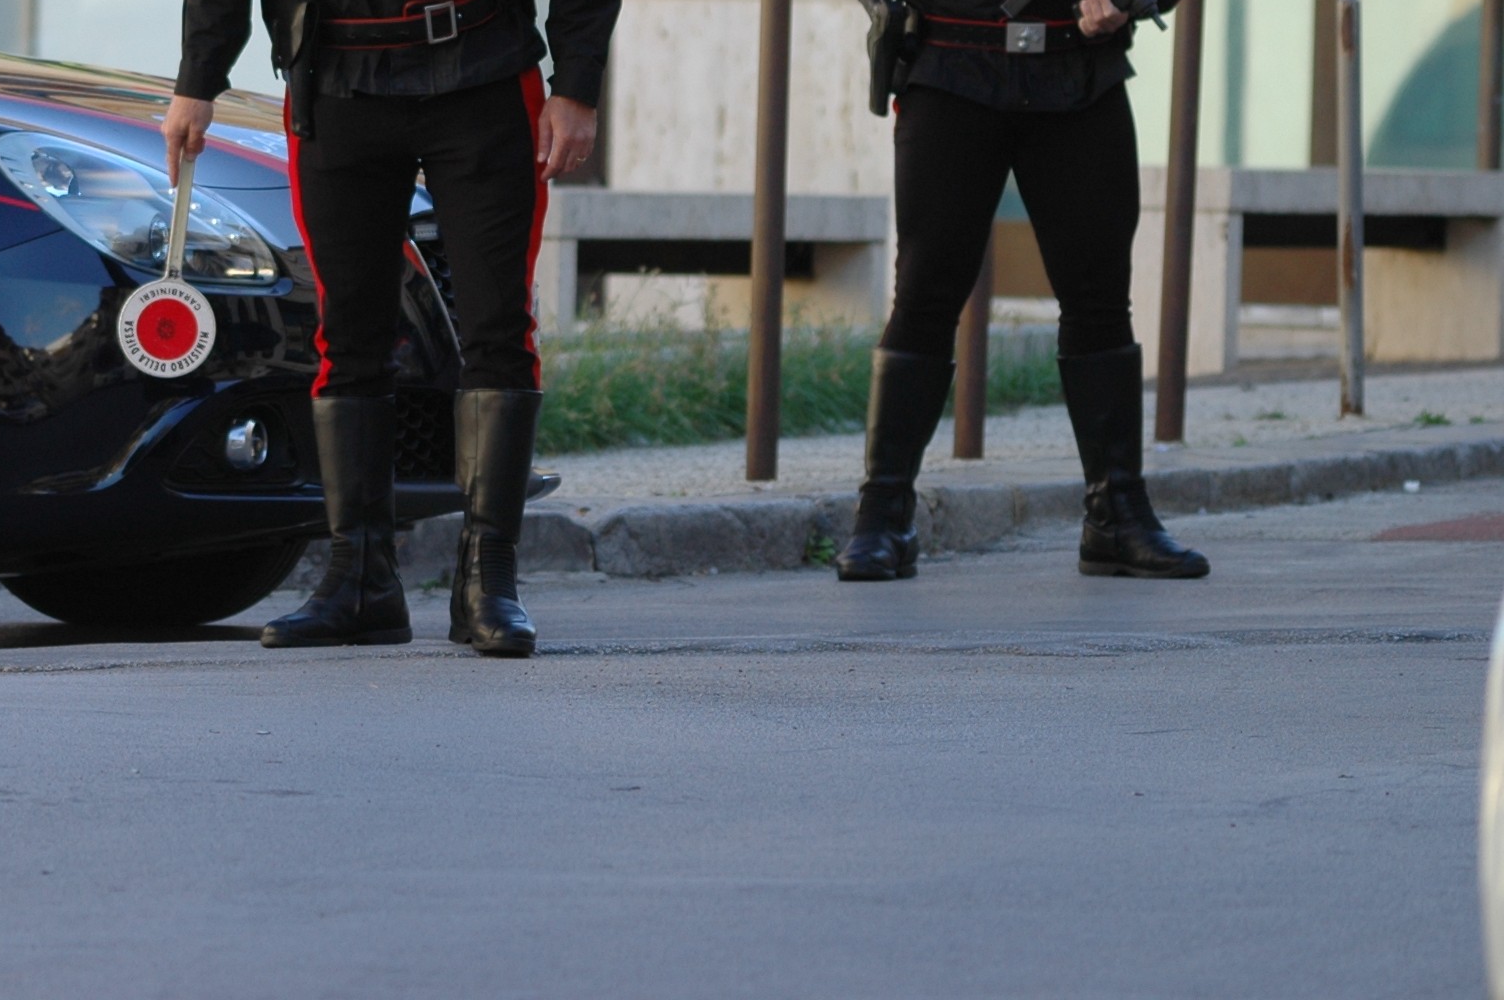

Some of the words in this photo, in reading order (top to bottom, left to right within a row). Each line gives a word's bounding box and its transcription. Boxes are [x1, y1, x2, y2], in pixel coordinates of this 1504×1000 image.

[140, 287, 201, 311] CARABINIERI
[124, 320, 137, 355] DIFESA
[171, 331, 209, 372] MINISTERO
[138, 355, 166, 372] DELLA
